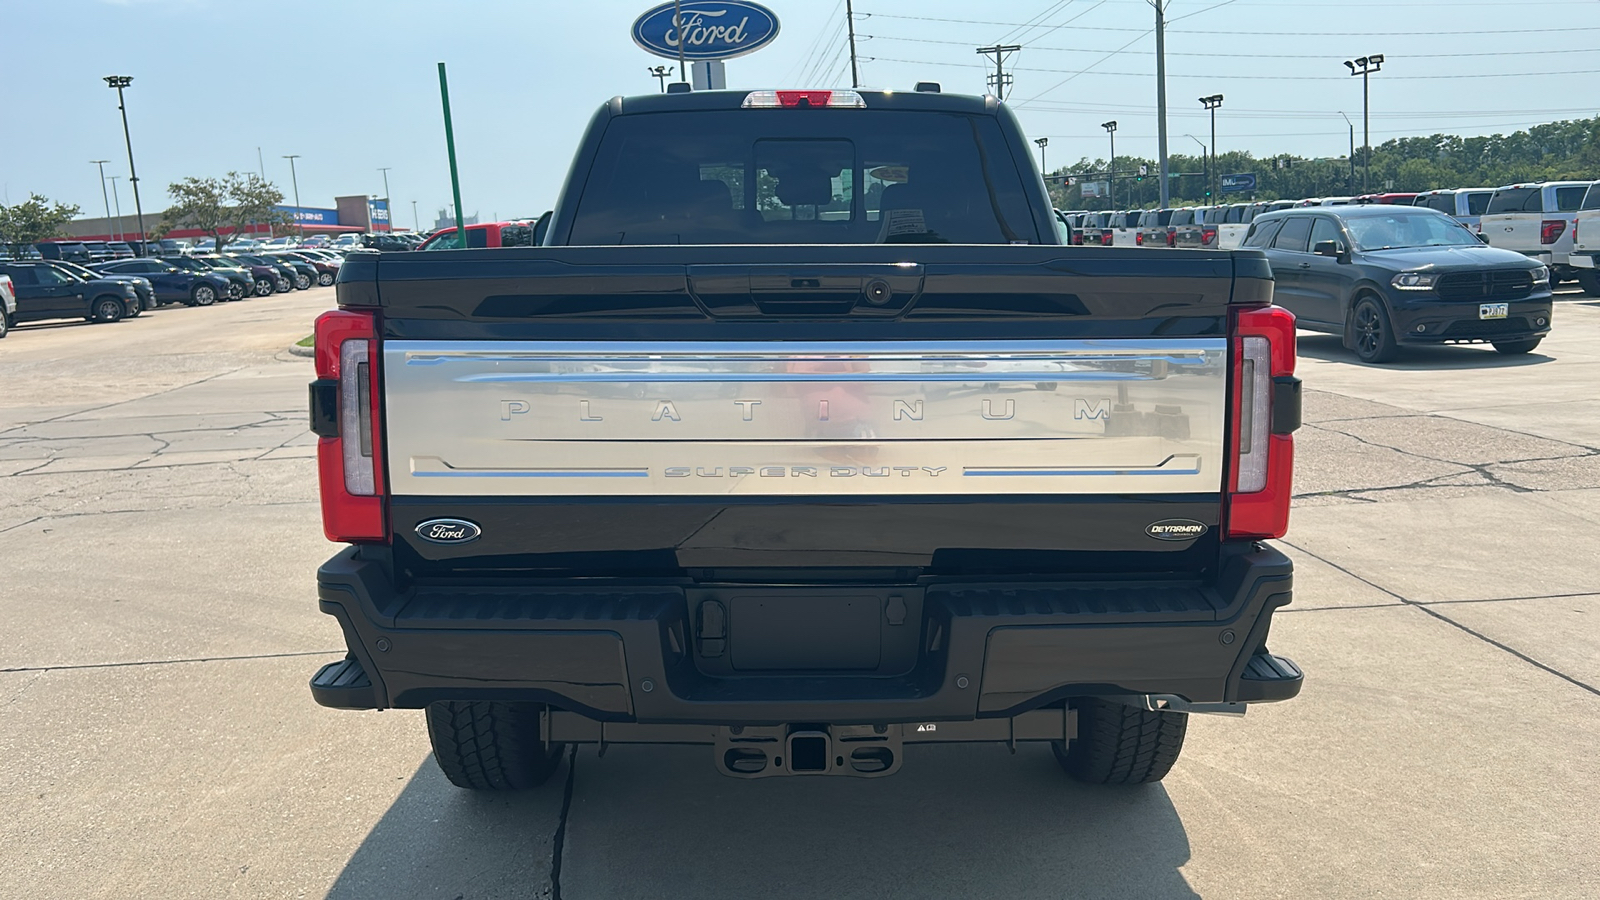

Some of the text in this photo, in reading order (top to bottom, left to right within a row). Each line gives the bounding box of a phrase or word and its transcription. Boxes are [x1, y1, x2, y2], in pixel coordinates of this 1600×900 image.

[664, 9, 749, 47] Ford
[500, 399, 1111, 421] PLATINUM
[664, 466, 948, 478] SUPER DUTY
[429, 524, 465, 539] Ford
[1151, 525, 1202, 533] DEYARMAN
